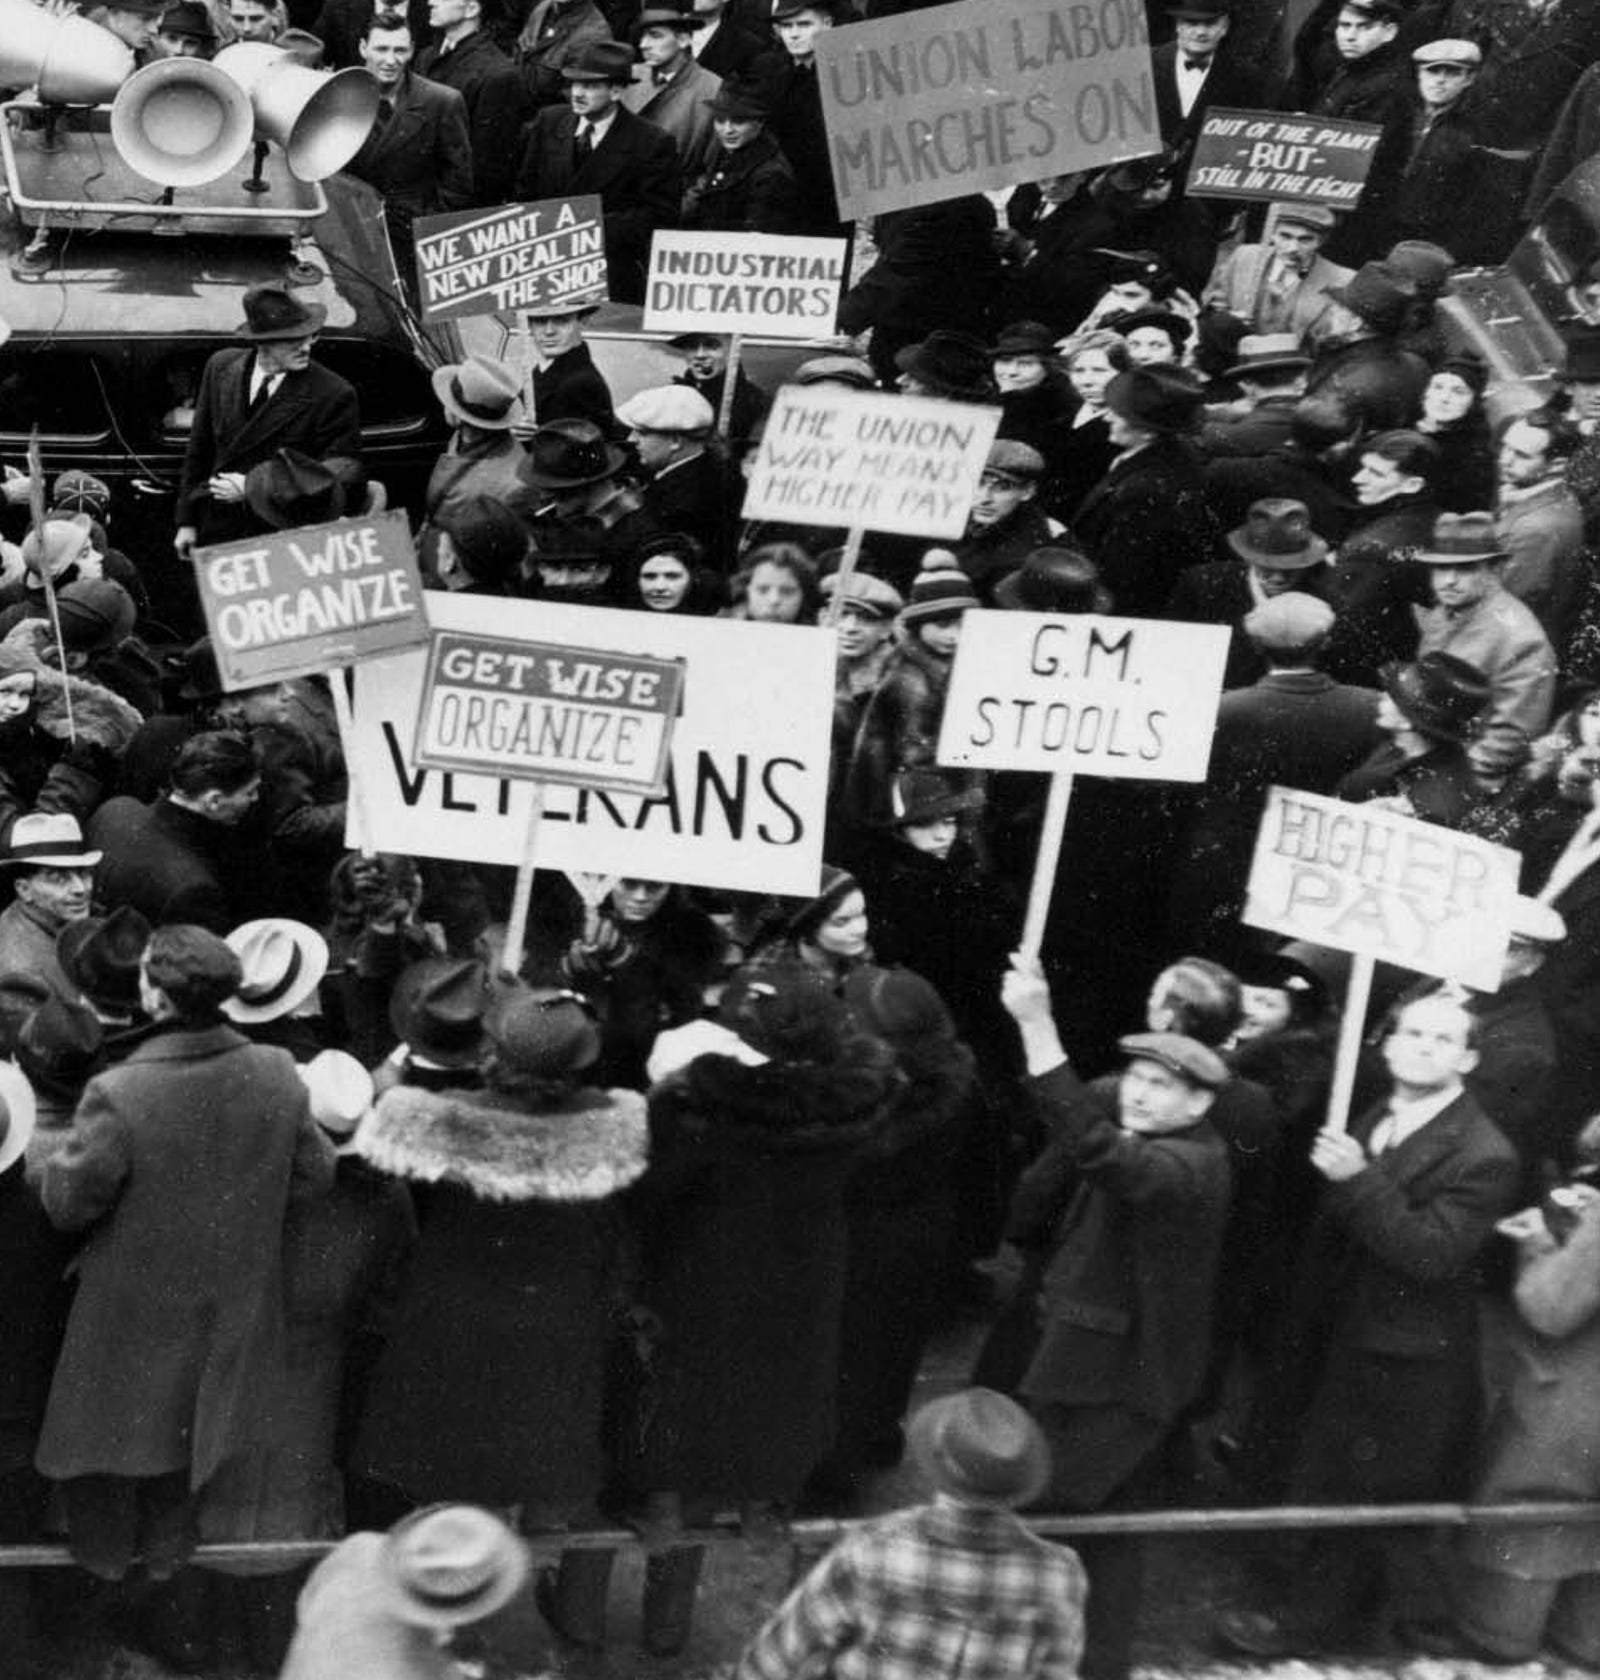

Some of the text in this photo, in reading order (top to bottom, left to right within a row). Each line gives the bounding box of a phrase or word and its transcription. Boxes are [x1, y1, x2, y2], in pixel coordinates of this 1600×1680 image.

[829, 25, 992, 107] UNION
[832, 71, 1151, 199] MARCHES ON
[1201, 118, 1381, 151] OUT OF THE PLANT
[1270, 173, 1310, 193] THE
[418, 203, 576, 270] WE WANT A
[427, 226, 602, 301] NEW DEAL IN
[657, 250, 842, 281] INDUSTRIAL
[490, 258, 607, 310] THE SHOP
[651, 281, 831, 317] DICTATORS
[781, 405, 975, 451] THE UNION
[766, 442, 961, 482] WAY MEANS
[763, 475, 963, 519] HIGHER PAY
[208, 528, 384, 596] GET WISE
[217, 569, 416, 648] ORGANIZE
[441, 648, 535, 690] GET
[546, 659, 661, 707] WISE
[1031, 624, 1142, 685] G.M.
[438, 693, 642, 766] ORGANIZE
[970, 697, 1167, 761] STOOLS
[1273, 798, 1489, 912] HIGHER
